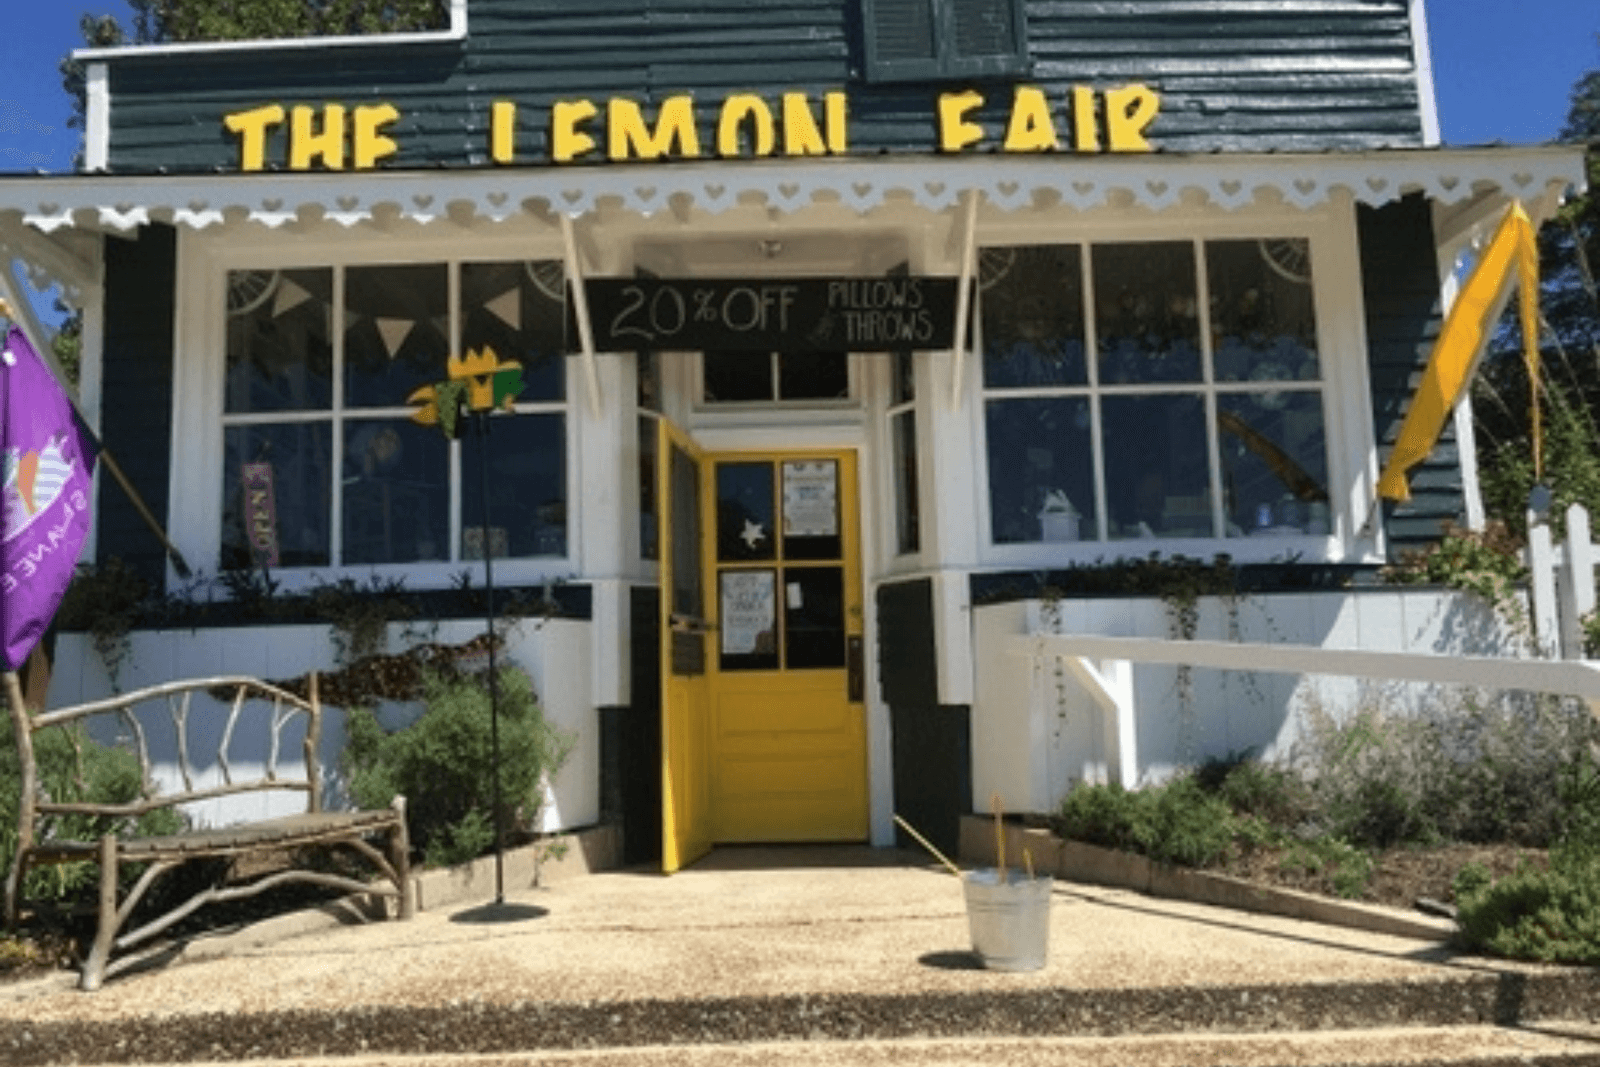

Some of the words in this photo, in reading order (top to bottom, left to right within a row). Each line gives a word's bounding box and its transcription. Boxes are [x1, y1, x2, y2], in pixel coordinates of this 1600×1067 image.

[223, 103, 399, 172] THE
[491, 92, 848, 162] LEMON
[937, 82, 1160, 153] FAIR
[827, 278, 924, 309] PILLOWS
[841, 308, 935, 344] THROWS
